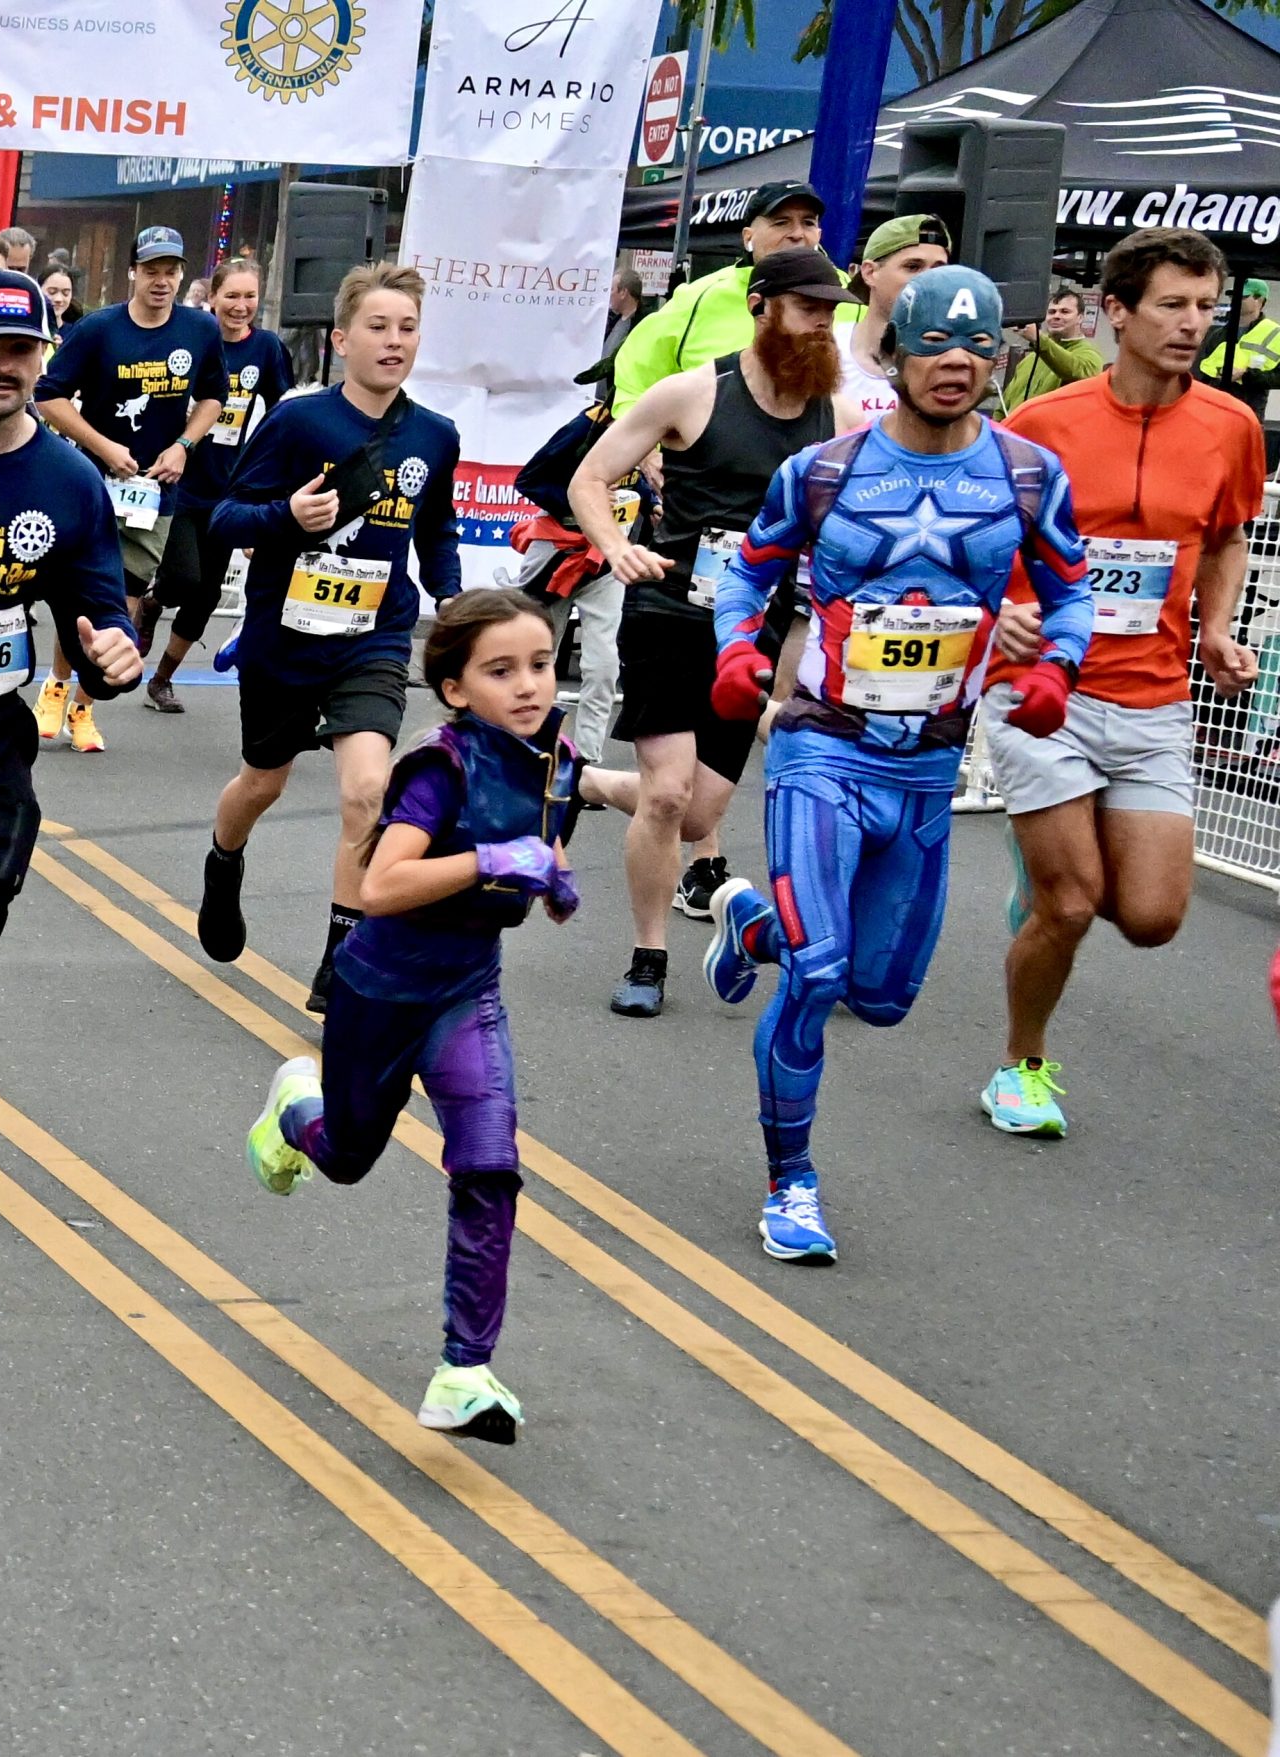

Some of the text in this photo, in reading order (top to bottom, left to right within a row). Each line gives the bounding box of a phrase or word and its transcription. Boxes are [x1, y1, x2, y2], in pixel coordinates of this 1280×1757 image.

[73, 19, 157, 35] ADVISORS
[240, 49, 341, 89] INTERNATIONAL
[457, 76, 614, 103] ARMARIO
[652, 75, 680, 96] DO NOT
[32, 95, 186, 136] FINISH
[478, 109, 592, 133] HOMES
[648, 123, 670, 143] ENTER
[412, 254, 600, 292] HERITAGE
[467, 290, 491, 301] OF
[502, 293, 597, 307] COMMERCE
[946, 288, 978, 320] A
[120, 488, 147, 505] 147
[856, 477, 911, 502] Robin
[313, 579, 362, 606] 514
[1087, 568, 1142, 594] 223
[881, 639, 941, 667] 591
